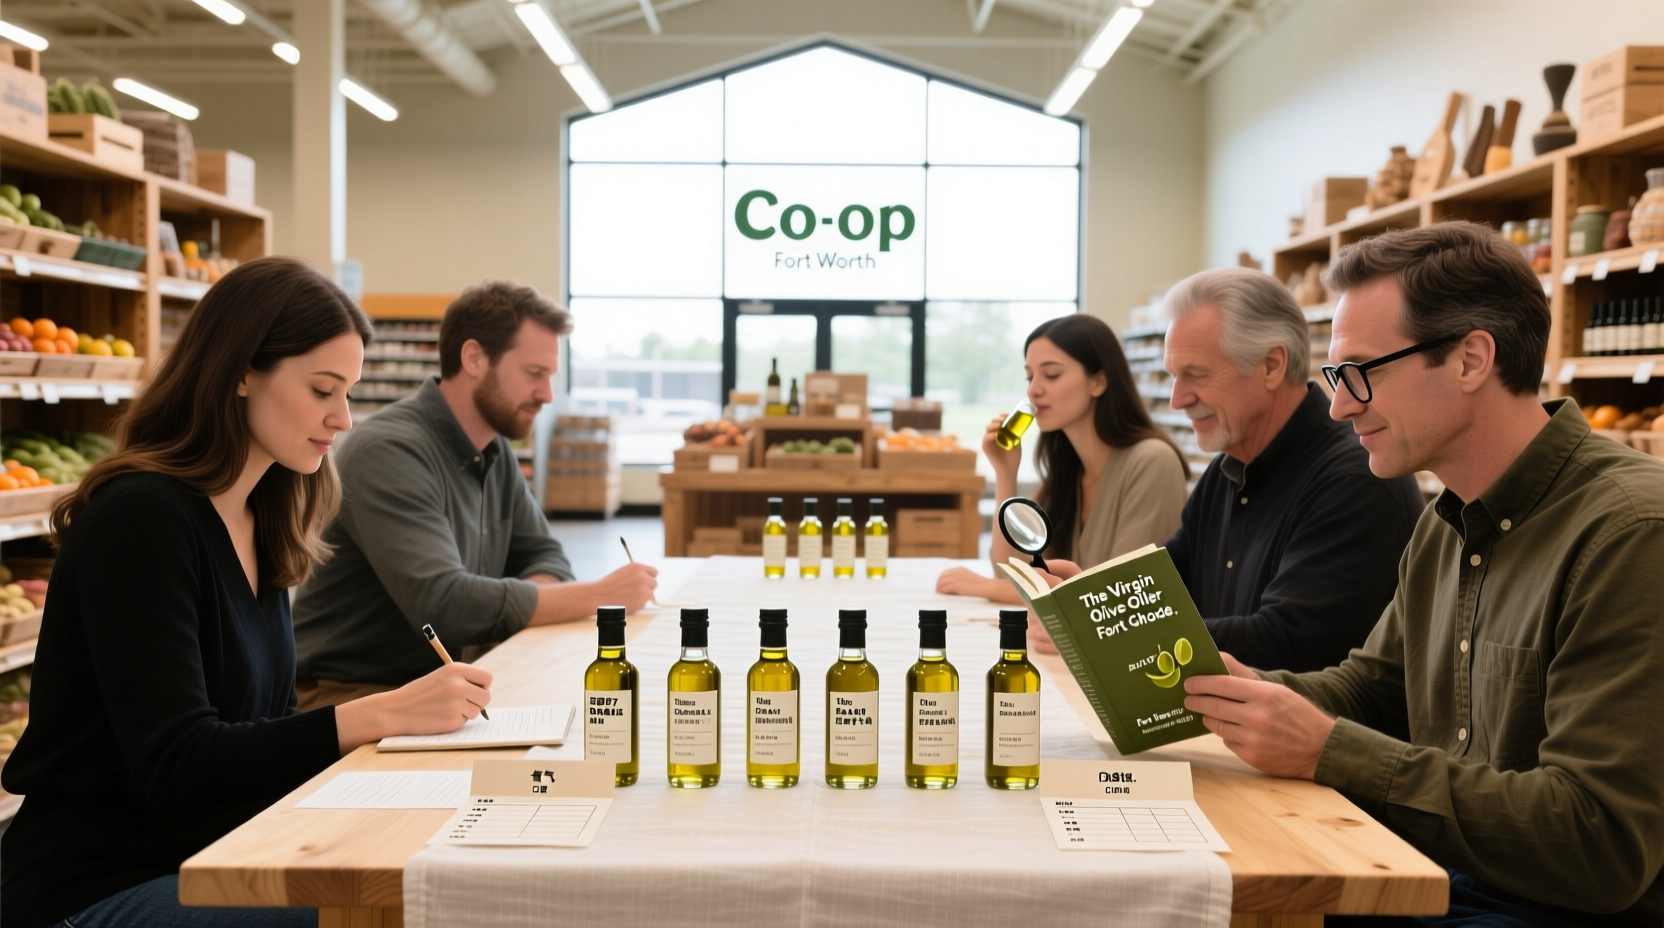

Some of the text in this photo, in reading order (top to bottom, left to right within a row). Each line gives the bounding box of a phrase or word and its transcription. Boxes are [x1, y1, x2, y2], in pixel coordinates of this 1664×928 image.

[734, 189, 916, 252] Co-op
[775, 252, 876, 269] Fort Worth
[1078, 574, 1155, 608] The Virgin
[1090, 603, 1127, 623] Olive
